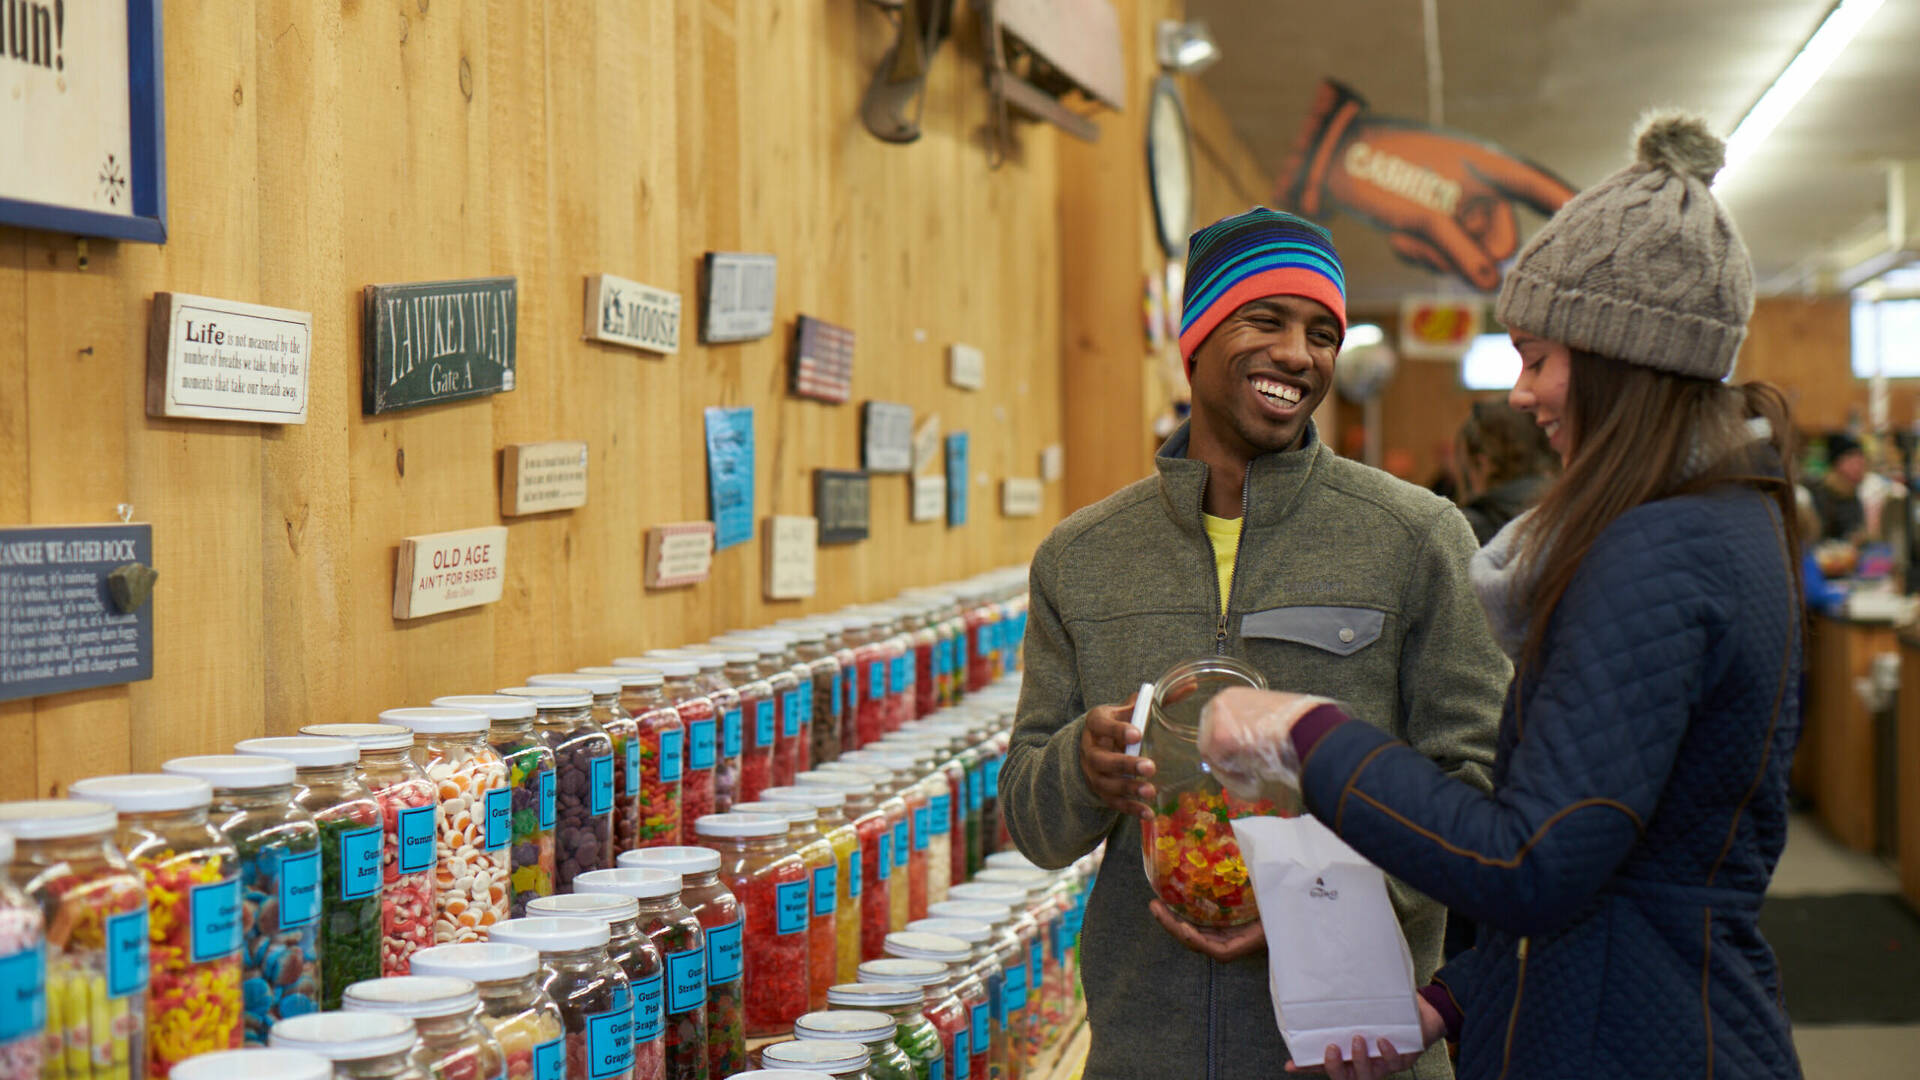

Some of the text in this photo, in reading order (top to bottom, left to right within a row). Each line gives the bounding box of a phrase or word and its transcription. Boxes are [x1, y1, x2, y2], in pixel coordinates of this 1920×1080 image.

[186, 320, 225, 345] Life
[227, 331, 234, 346] is
[235, 335, 246, 348] not
[248, 334, 279, 352] measured
[290, 336, 300, 354] the
[387, 289, 513, 386] YAWKEY WAY
[627, 301, 677, 348] MOOSE
[430, 360, 473, 395] Gate A
[0, 542, 43, 567] ANKEE
[46, 540, 102, 564] WEATHER
[432, 544, 490, 570] OLD AGE
[418, 567, 497, 591] AIN'T FOR SISSIES
